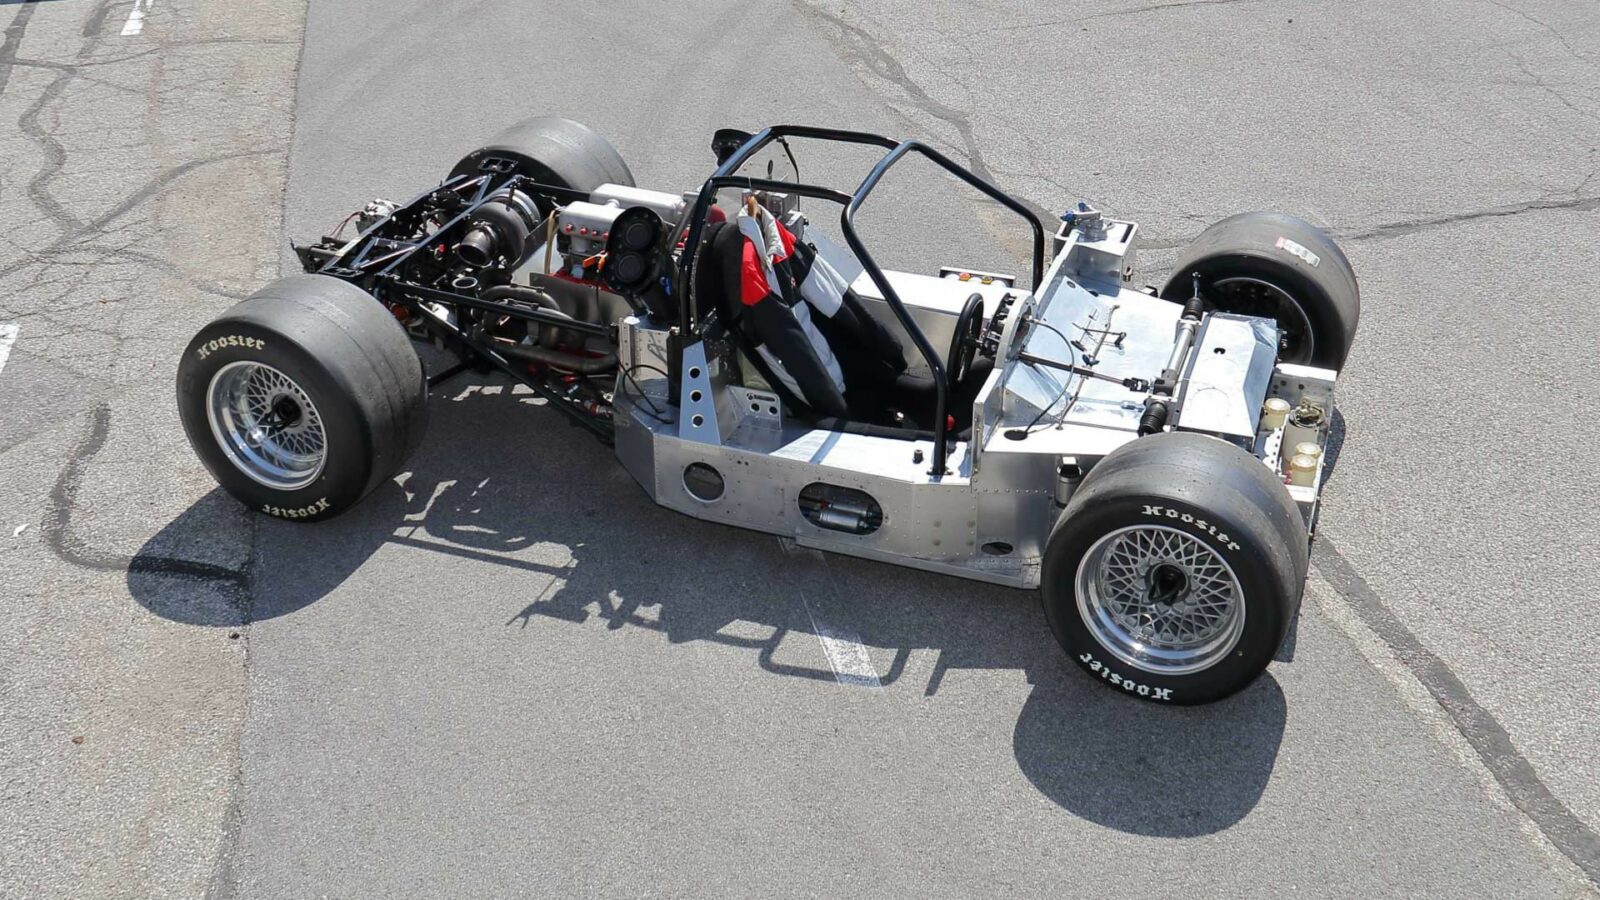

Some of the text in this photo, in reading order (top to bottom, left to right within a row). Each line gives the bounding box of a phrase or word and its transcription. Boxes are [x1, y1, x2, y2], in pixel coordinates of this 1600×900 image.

[197, 335, 266, 360] Hoosier
[262, 497, 331, 518] Hoosier
[1141, 504, 1241, 551] Hoosier
[1079, 652, 1173, 701] Hoosier
